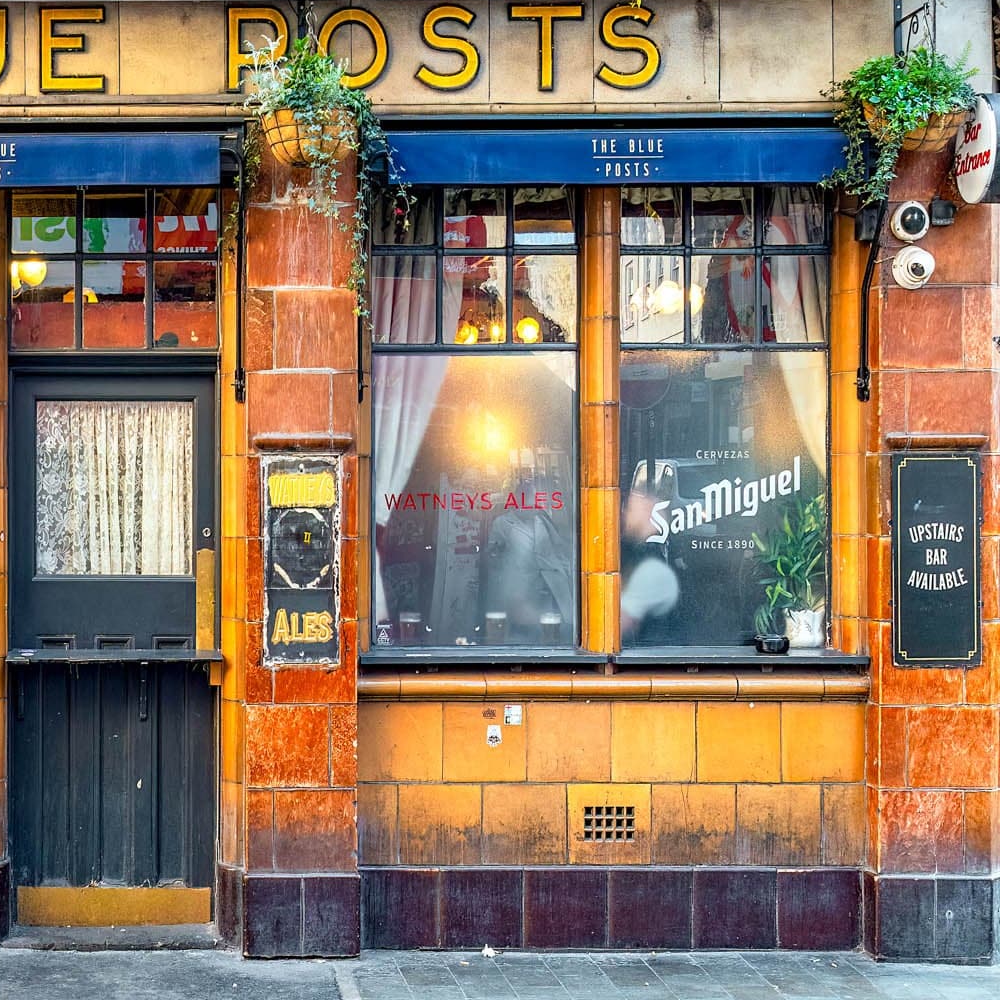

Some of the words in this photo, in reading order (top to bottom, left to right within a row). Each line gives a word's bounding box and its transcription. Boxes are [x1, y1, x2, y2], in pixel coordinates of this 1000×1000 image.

[226, 4, 661, 93] POSTS
[592, 139, 617, 153] THE
[629, 139, 664, 153] BLUE
[955, 149, 991, 176] Entrance
[385, 492, 493, 511] WATNEYS
[503, 491, 564, 510] ALES
[646, 500, 702, 544] San
[700, 455, 801, 523] Miguel
[727, 539, 755, 549] 1890
[908, 522, 966, 544] UPSTAIRS
[925, 549, 947, 566] BAR
[906, 567, 968, 591] AVAILABLE
[271, 608, 333, 644] ALES
